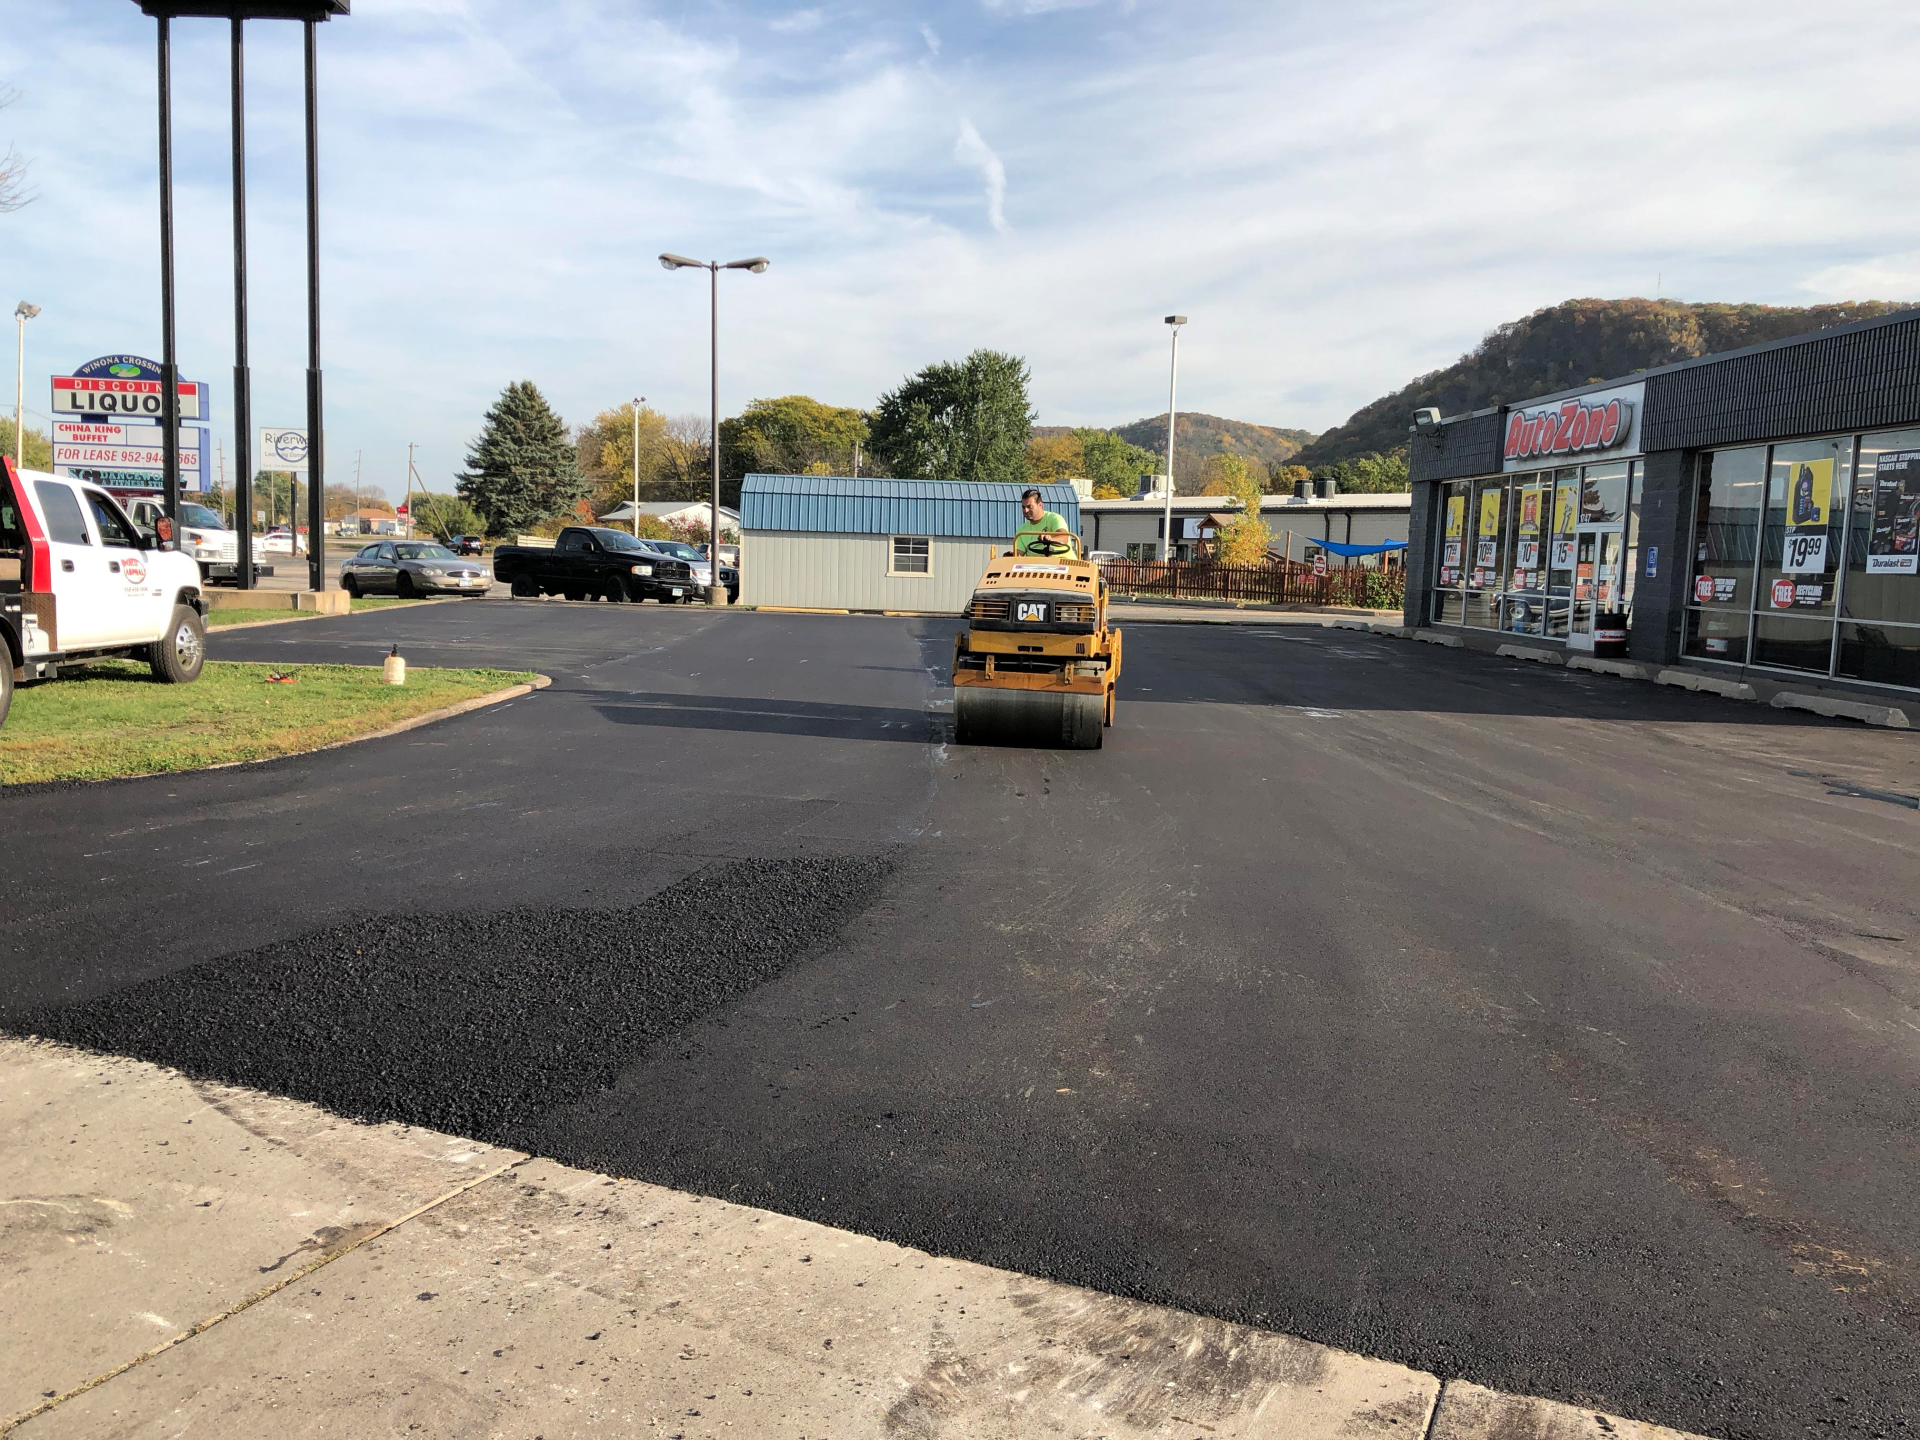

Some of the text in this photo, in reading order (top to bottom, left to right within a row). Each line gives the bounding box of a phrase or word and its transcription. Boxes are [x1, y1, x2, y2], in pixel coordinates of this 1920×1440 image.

[82, 356, 162, 375] WINONA CROSSIN
[74, 379, 163, 392] DISCOUN
[58, 424, 122, 434] CHINA KING
[1504, 399, 1621, 460] AutoZone
[72, 433, 108, 442] BUFFET
[57, 448, 197, 464] FOR LEASE 952-944665
[1879, 454, 1898, 462] NASCAR
[1786, 526, 1797, 534] STP
[1872, 558, 1900, 567] Duralast
[1697, 580, 1712, 597] FREE
[1774, 585, 1793, 602] FREE
[1018, 603, 1047, 621] CAT
